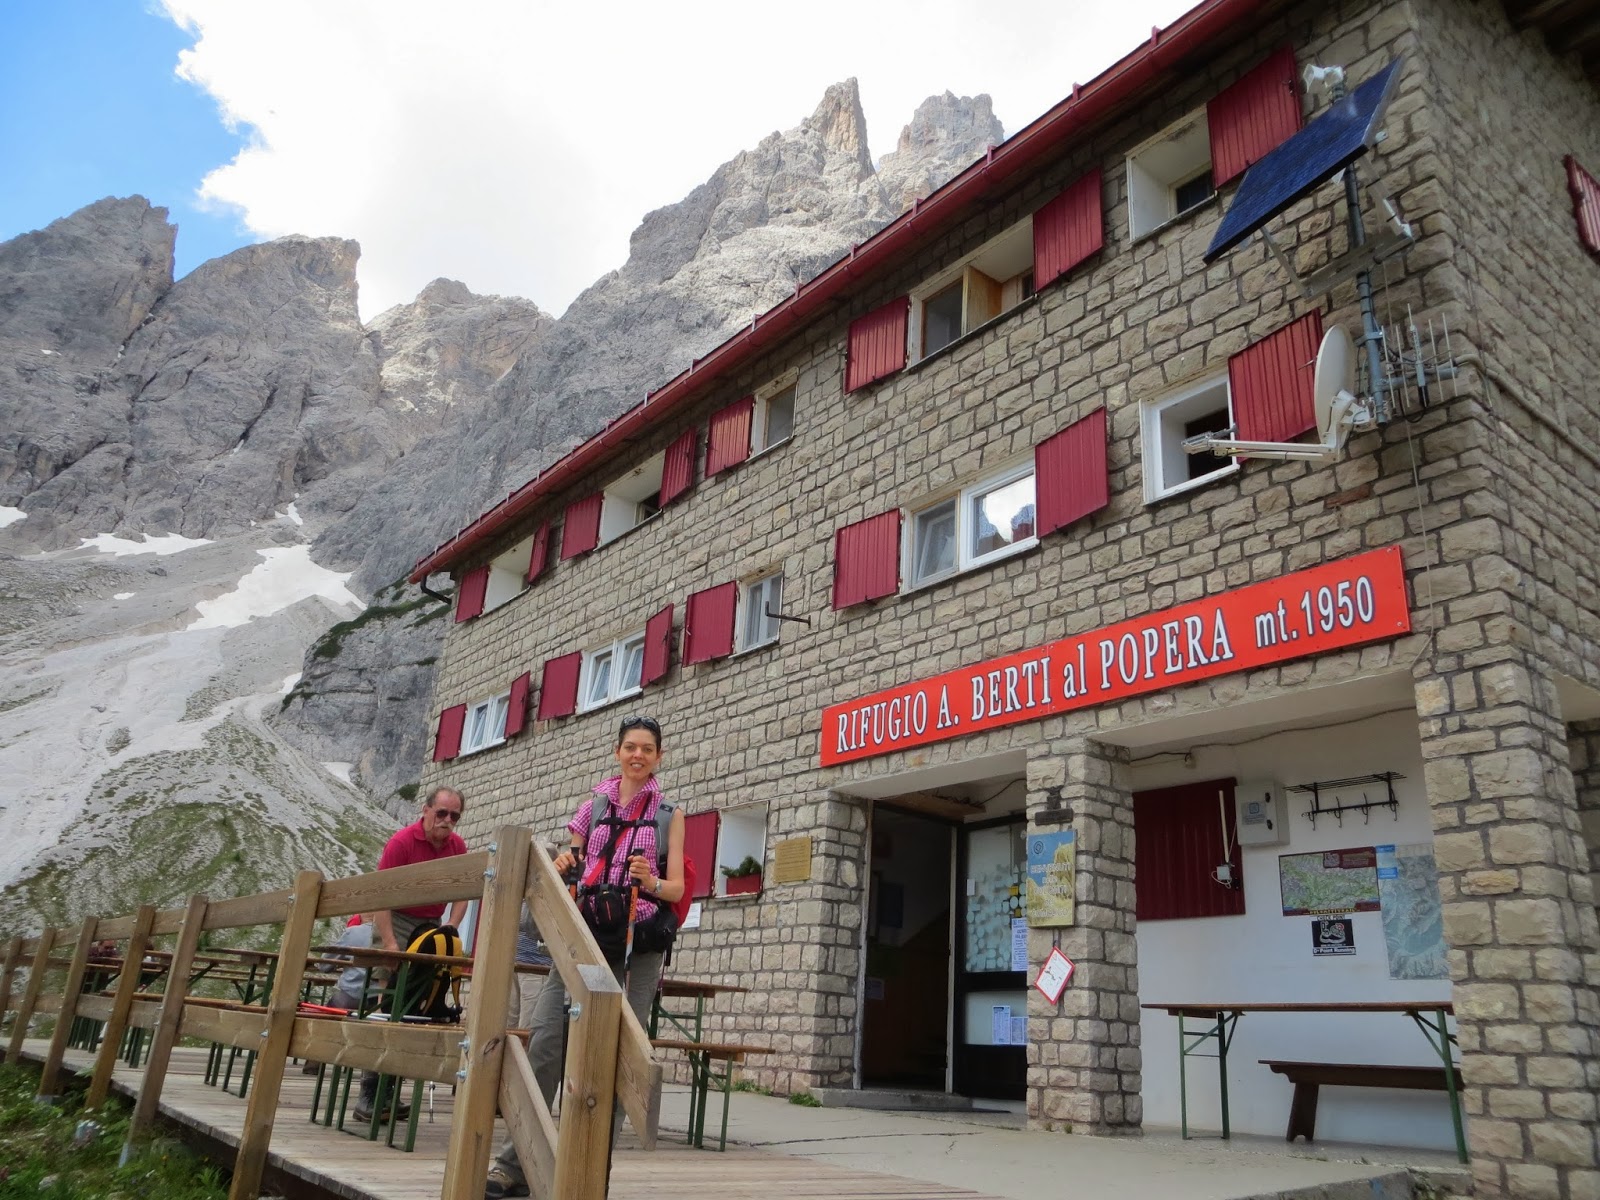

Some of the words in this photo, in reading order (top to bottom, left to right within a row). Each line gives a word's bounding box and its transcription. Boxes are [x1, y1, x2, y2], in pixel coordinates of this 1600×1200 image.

[836, 690, 928, 755] RIFUGIO
[936, 684, 960, 730] A.
[971, 656, 1052, 722] BERTI
[1063, 643, 1088, 700] al
[1099, 607, 1235, 690] POPERA
